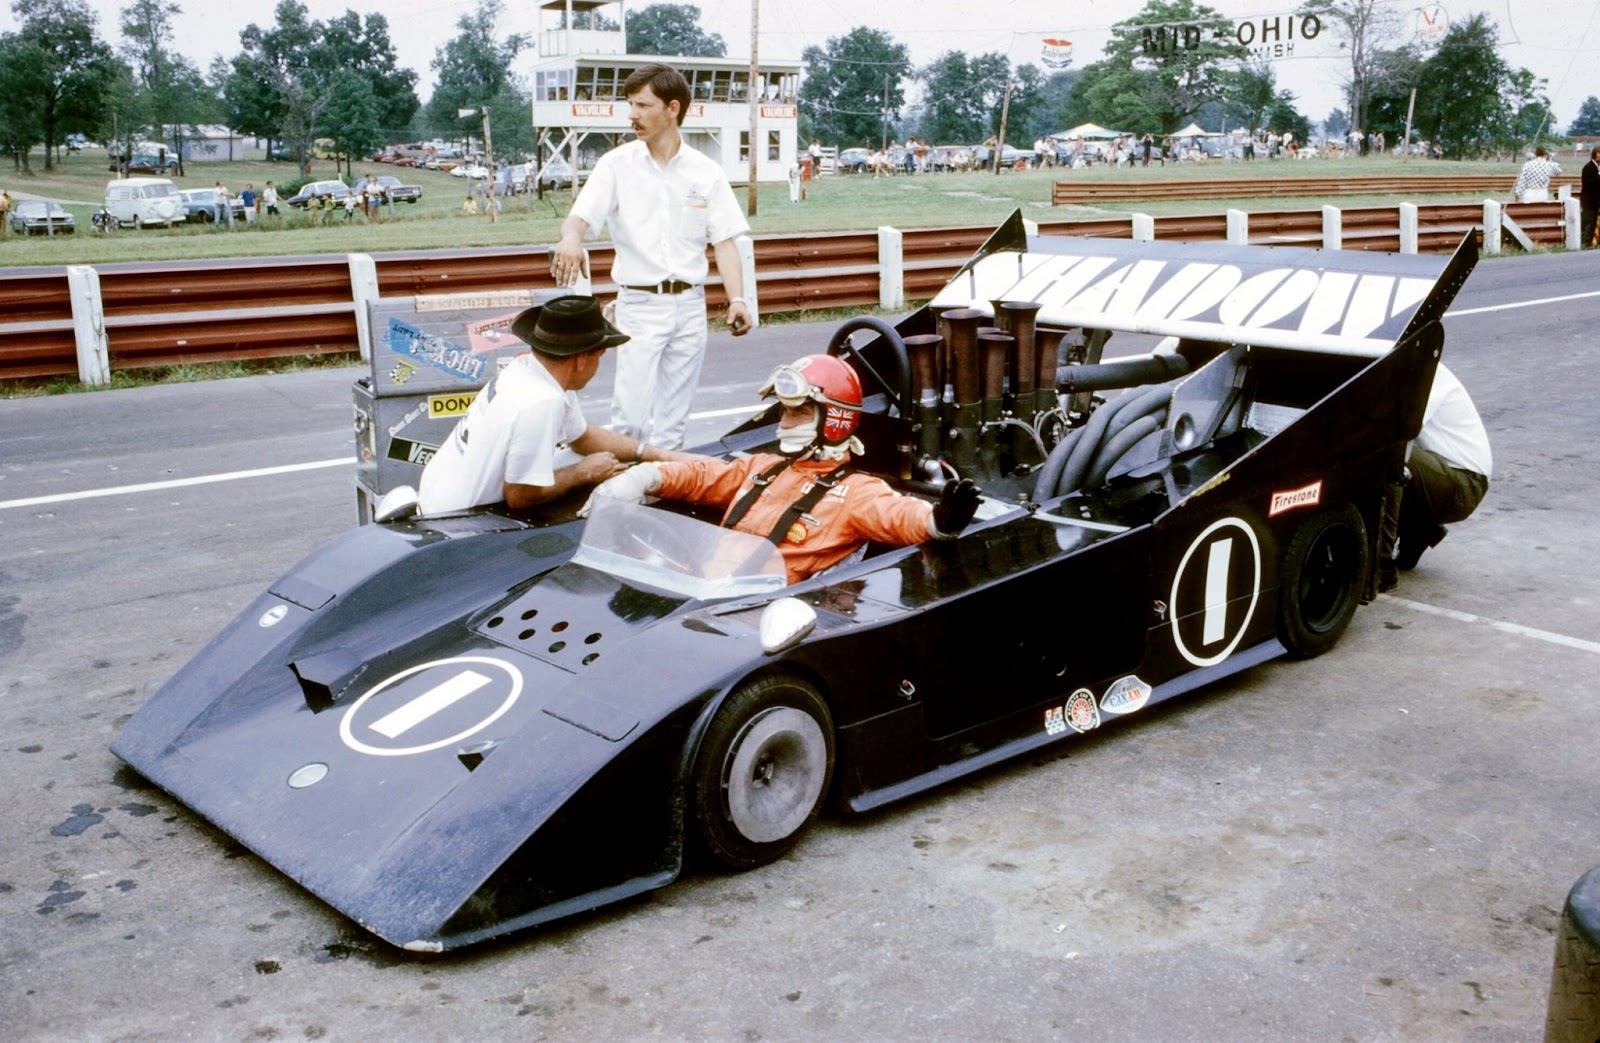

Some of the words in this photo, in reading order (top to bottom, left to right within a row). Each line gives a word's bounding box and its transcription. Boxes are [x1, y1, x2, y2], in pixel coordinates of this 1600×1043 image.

[1237, 15, 1321, 46] OHIO
[433, 346, 482, 379] LUCY
[433, 397, 476, 413] DON
[1275, 490, 1317, 509] Firestone
[1203, 538, 1233, 646] 1
[368, 670, 493, 739] 1
